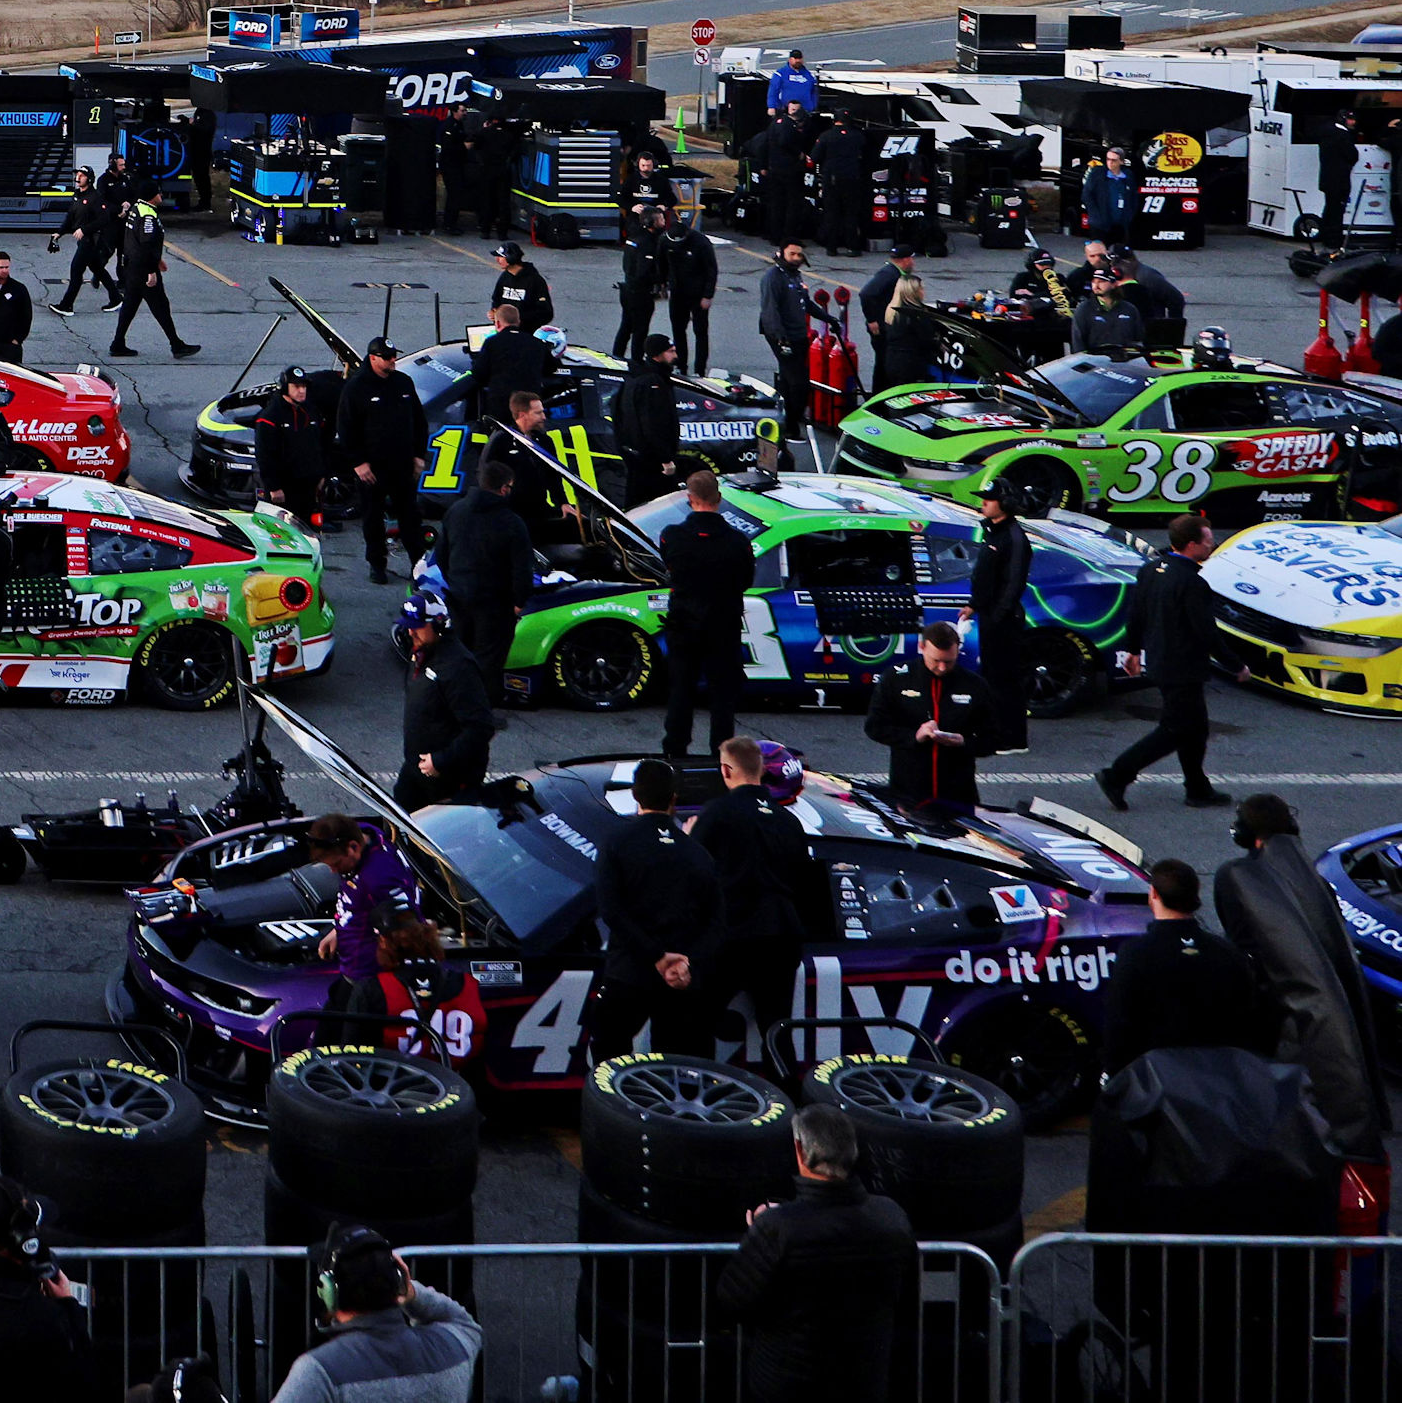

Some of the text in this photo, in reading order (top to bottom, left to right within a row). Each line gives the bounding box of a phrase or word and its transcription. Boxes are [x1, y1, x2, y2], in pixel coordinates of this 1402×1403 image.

[234, 20, 269, 35] FORD
[314, 17, 349, 32] FORD
[692, 26, 714, 40] STOP
[1125, 71, 1152, 79] United
[89, 106, 101, 124] 1
[880, 135, 921, 159] 54
[1163, 133, 1188, 147] Bass
[1163, 145, 1183, 156] Pro
[1164, 154, 1195, 168] Shops
[1145, 176, 1198, 187] TRACKER
[1142, 195, 1166, 214] 19
[1262, 208, 1275, 226] 11
[1152, 230, 1185, 241] JGR
[1104, 370, 1136, 385] SMITH
[32, 419, 78, 435] Lane
[66, 445, 109, 461] DEX
[1254, 432, 1336, 460] SPEEDY
[76, 457, 114, 466] imaging
[417, 424, 471, 493] 1
[1107, 438, 1220, 504] 38
[1256, 489, 1312, 503] Aaron's
[26, 513, 63, 524] BUESCHER
[89, 512, 179, 539] FASTENAL FIFTH THIRD
[1236, 539, 1401, 607] SILVER'S
[73, 591, 143, 628] TOP
[571, 602, 642, 619] GOODYEAR
[48, 627, 134, 640] Grower Owned Since 1960
[256, 623, 293, 641] TREE TOP
[554, 651, 566, 688] EAGLE
[627, 630, 653, 700] GOODYEAR
[61, 668, 91, 683] Kroger
[67, 689, 116, 700] FORD
[944, 945, 1042, 985] do it
[1048, 1006, 1090, 1046] EAGLE
[281, 1044, 376, 1077] GOODYEAR
[106, 1058, 170, 1085] EAGLE
[593, 1052, 665, 1095] GOODYEAR
[813, 1054, 910, 1085] GOODYEAR
